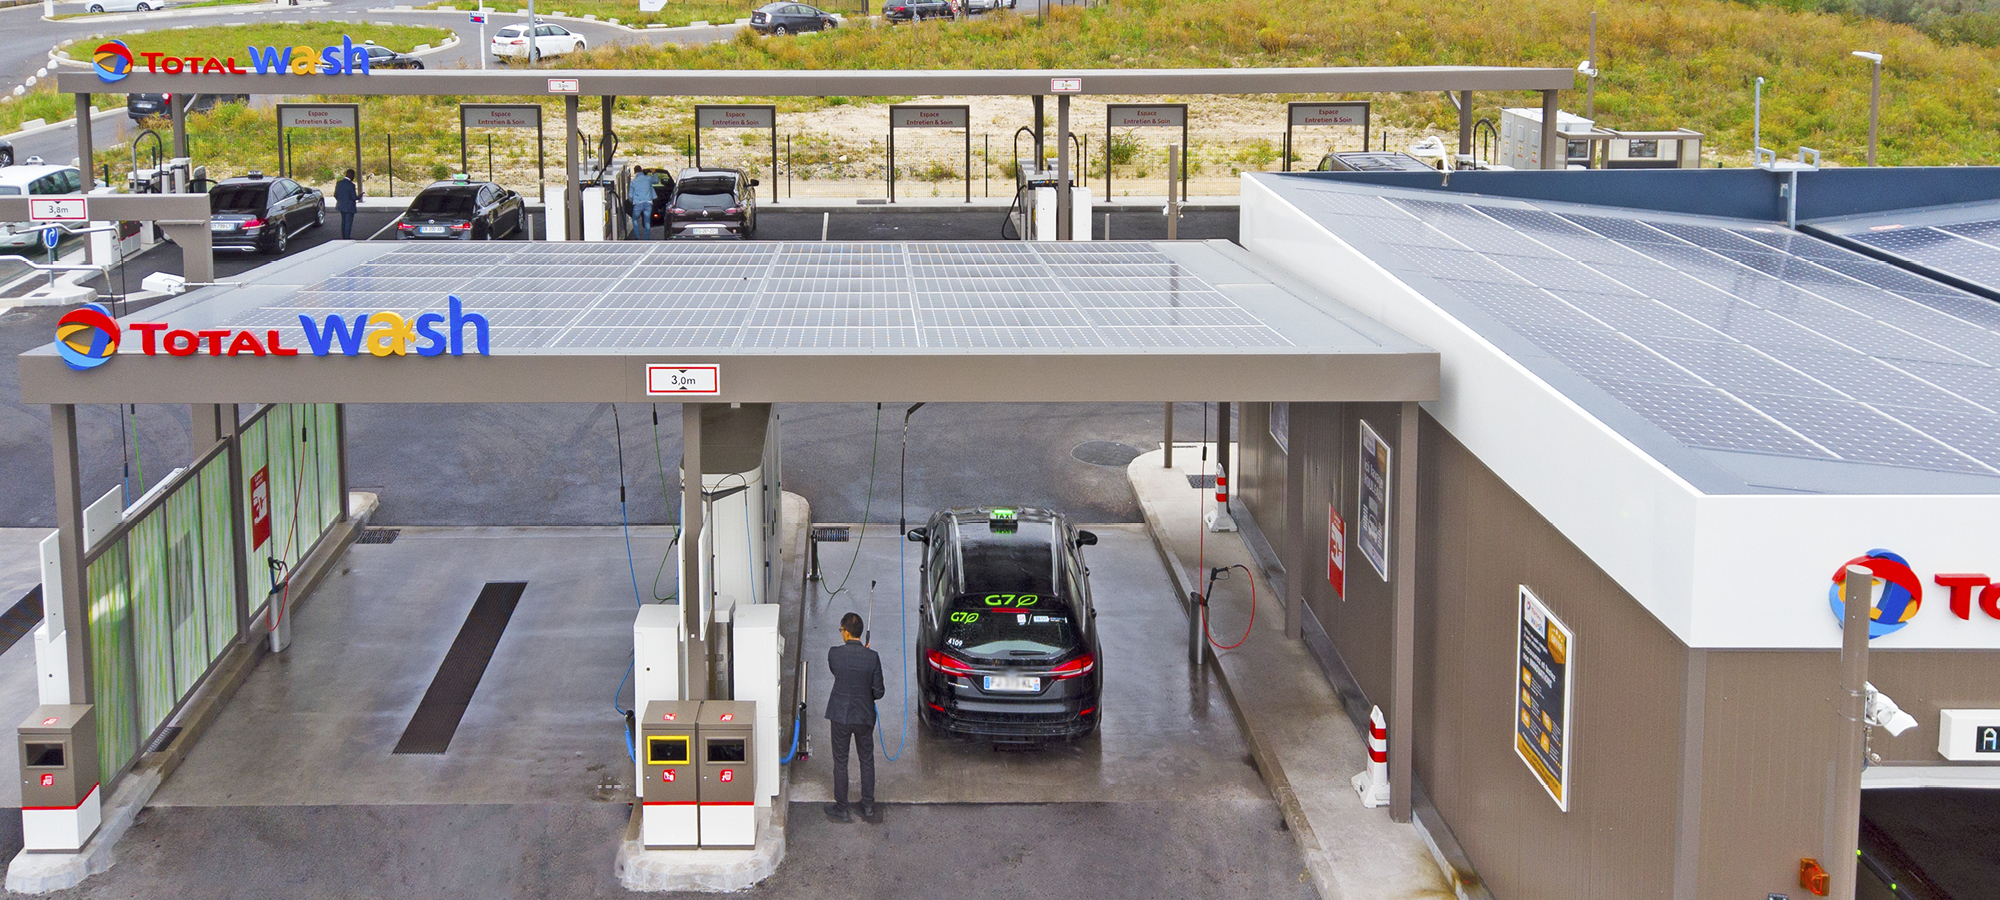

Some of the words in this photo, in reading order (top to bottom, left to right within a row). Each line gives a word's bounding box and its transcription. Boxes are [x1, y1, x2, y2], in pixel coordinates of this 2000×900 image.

[140, 52, 247, 75] TOTAL
[247, 34, 370, 76] wash
[48, 205, 68, 214] 3,8m
[129, 322, 298, 357] TOTAL
[298, 293, 490, 357] wash
[671, 374, 696, 385] 3,0m
[984, 594, 1016, 606] G7
[950, 612, 967, 622] G7
[946, 637, 963, 647] 4109
